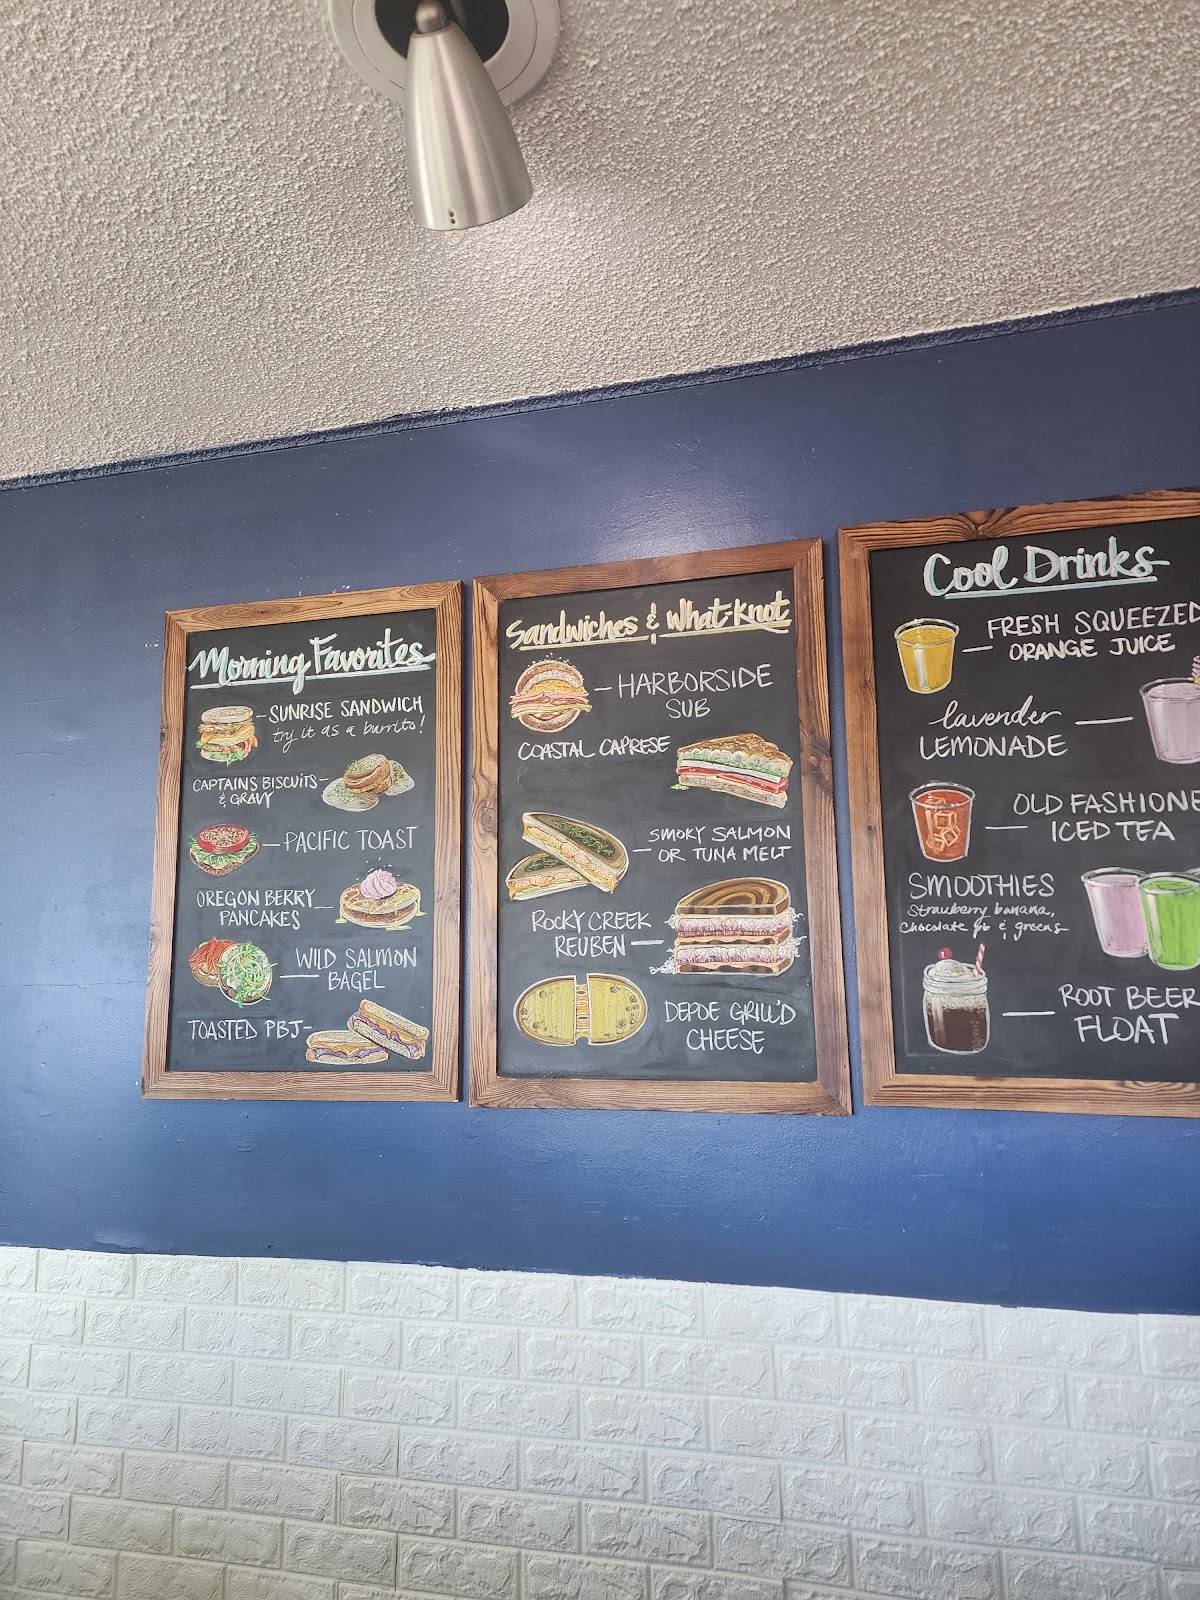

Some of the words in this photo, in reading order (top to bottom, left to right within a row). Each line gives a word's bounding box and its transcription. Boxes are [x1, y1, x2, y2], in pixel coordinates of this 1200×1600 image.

[924, 545, 1018, 596] Cool
[1023, 536, 1170, 583] Drinks
[506, 610, 639, 649] Sandwiches
[987, 613, 1060, 638] FRESH
[1075, 601, 1200, 635] SQUEEZED
[1009, 638, 1097, 661] ORANGE
[1109, 633, 1176, 656] JUICE
[188, 646, 311, 695] Morning
[309, 628, 436, 673] Favorites
[618, 664, 774, 698] HARBORSIDE
[269, 702, 333, 723] SUNRISE
[341, 695, 423, 718] SANDWICH
[665, 698, 711, 719] SUB
[929, 695, 1062, 729] lavender
[272, 730, 298, 753] try
[301, 724, 315, 739] it
[321, 724, 339, 737] as
[346, 724, 355, 736] a
[363, 715, 426, 735] burrito!
[518, 740, 596, 761] COASTAL
[599, 735, 671, 757] CAPRESE
[919, 735, 1068, 760] LEMONADE
[193, 776, 258, 791] CAPTAINS
[230, 792, 273, 808] GRAVY
[1014, 793, 1062, 815] OLD
[283, 830, 350, 851] PACIFIC
[357, 826, 417, 849] TOAST
[649, 826, 706, 842] SMOKY
[712, 825, 791, 840] SALMON
[1051, 821, 1110, 842] ICED
[1115, 820, 1176, 841] TEA
[658, 848, 686, 862] OR
[693, 847, 736, 863] TUNA
[743, 846, 792, 862] MELT
[909, 872, 1055, 900] SMOOTHIES
[197, 890, 260, 908] OREGON
[264, 889, 316, 908] BERRY
[220, 910, 300, 929] PANCAKES
[587, 911, 652, 930] CREEK
[1014, 921, 1070, 941] greens
[555, 935, 626, 957] REUBEN
[296, 947, 337, 969] WILD
[346, 947, 417, 968] SALMON
[328, 970, 385, 992] BAGEL
[1059, 983, 1116, 1007] ROOT
[1127, 986, 1200, 1009] BEER
[664, 1001, 721, 1023] DEPOE
[188, 1019, 257, 1040] TOASTED
[1074, 1012, 1179, 1045] FLOAT
[686, 1028, 766, 1054] CHEESE
